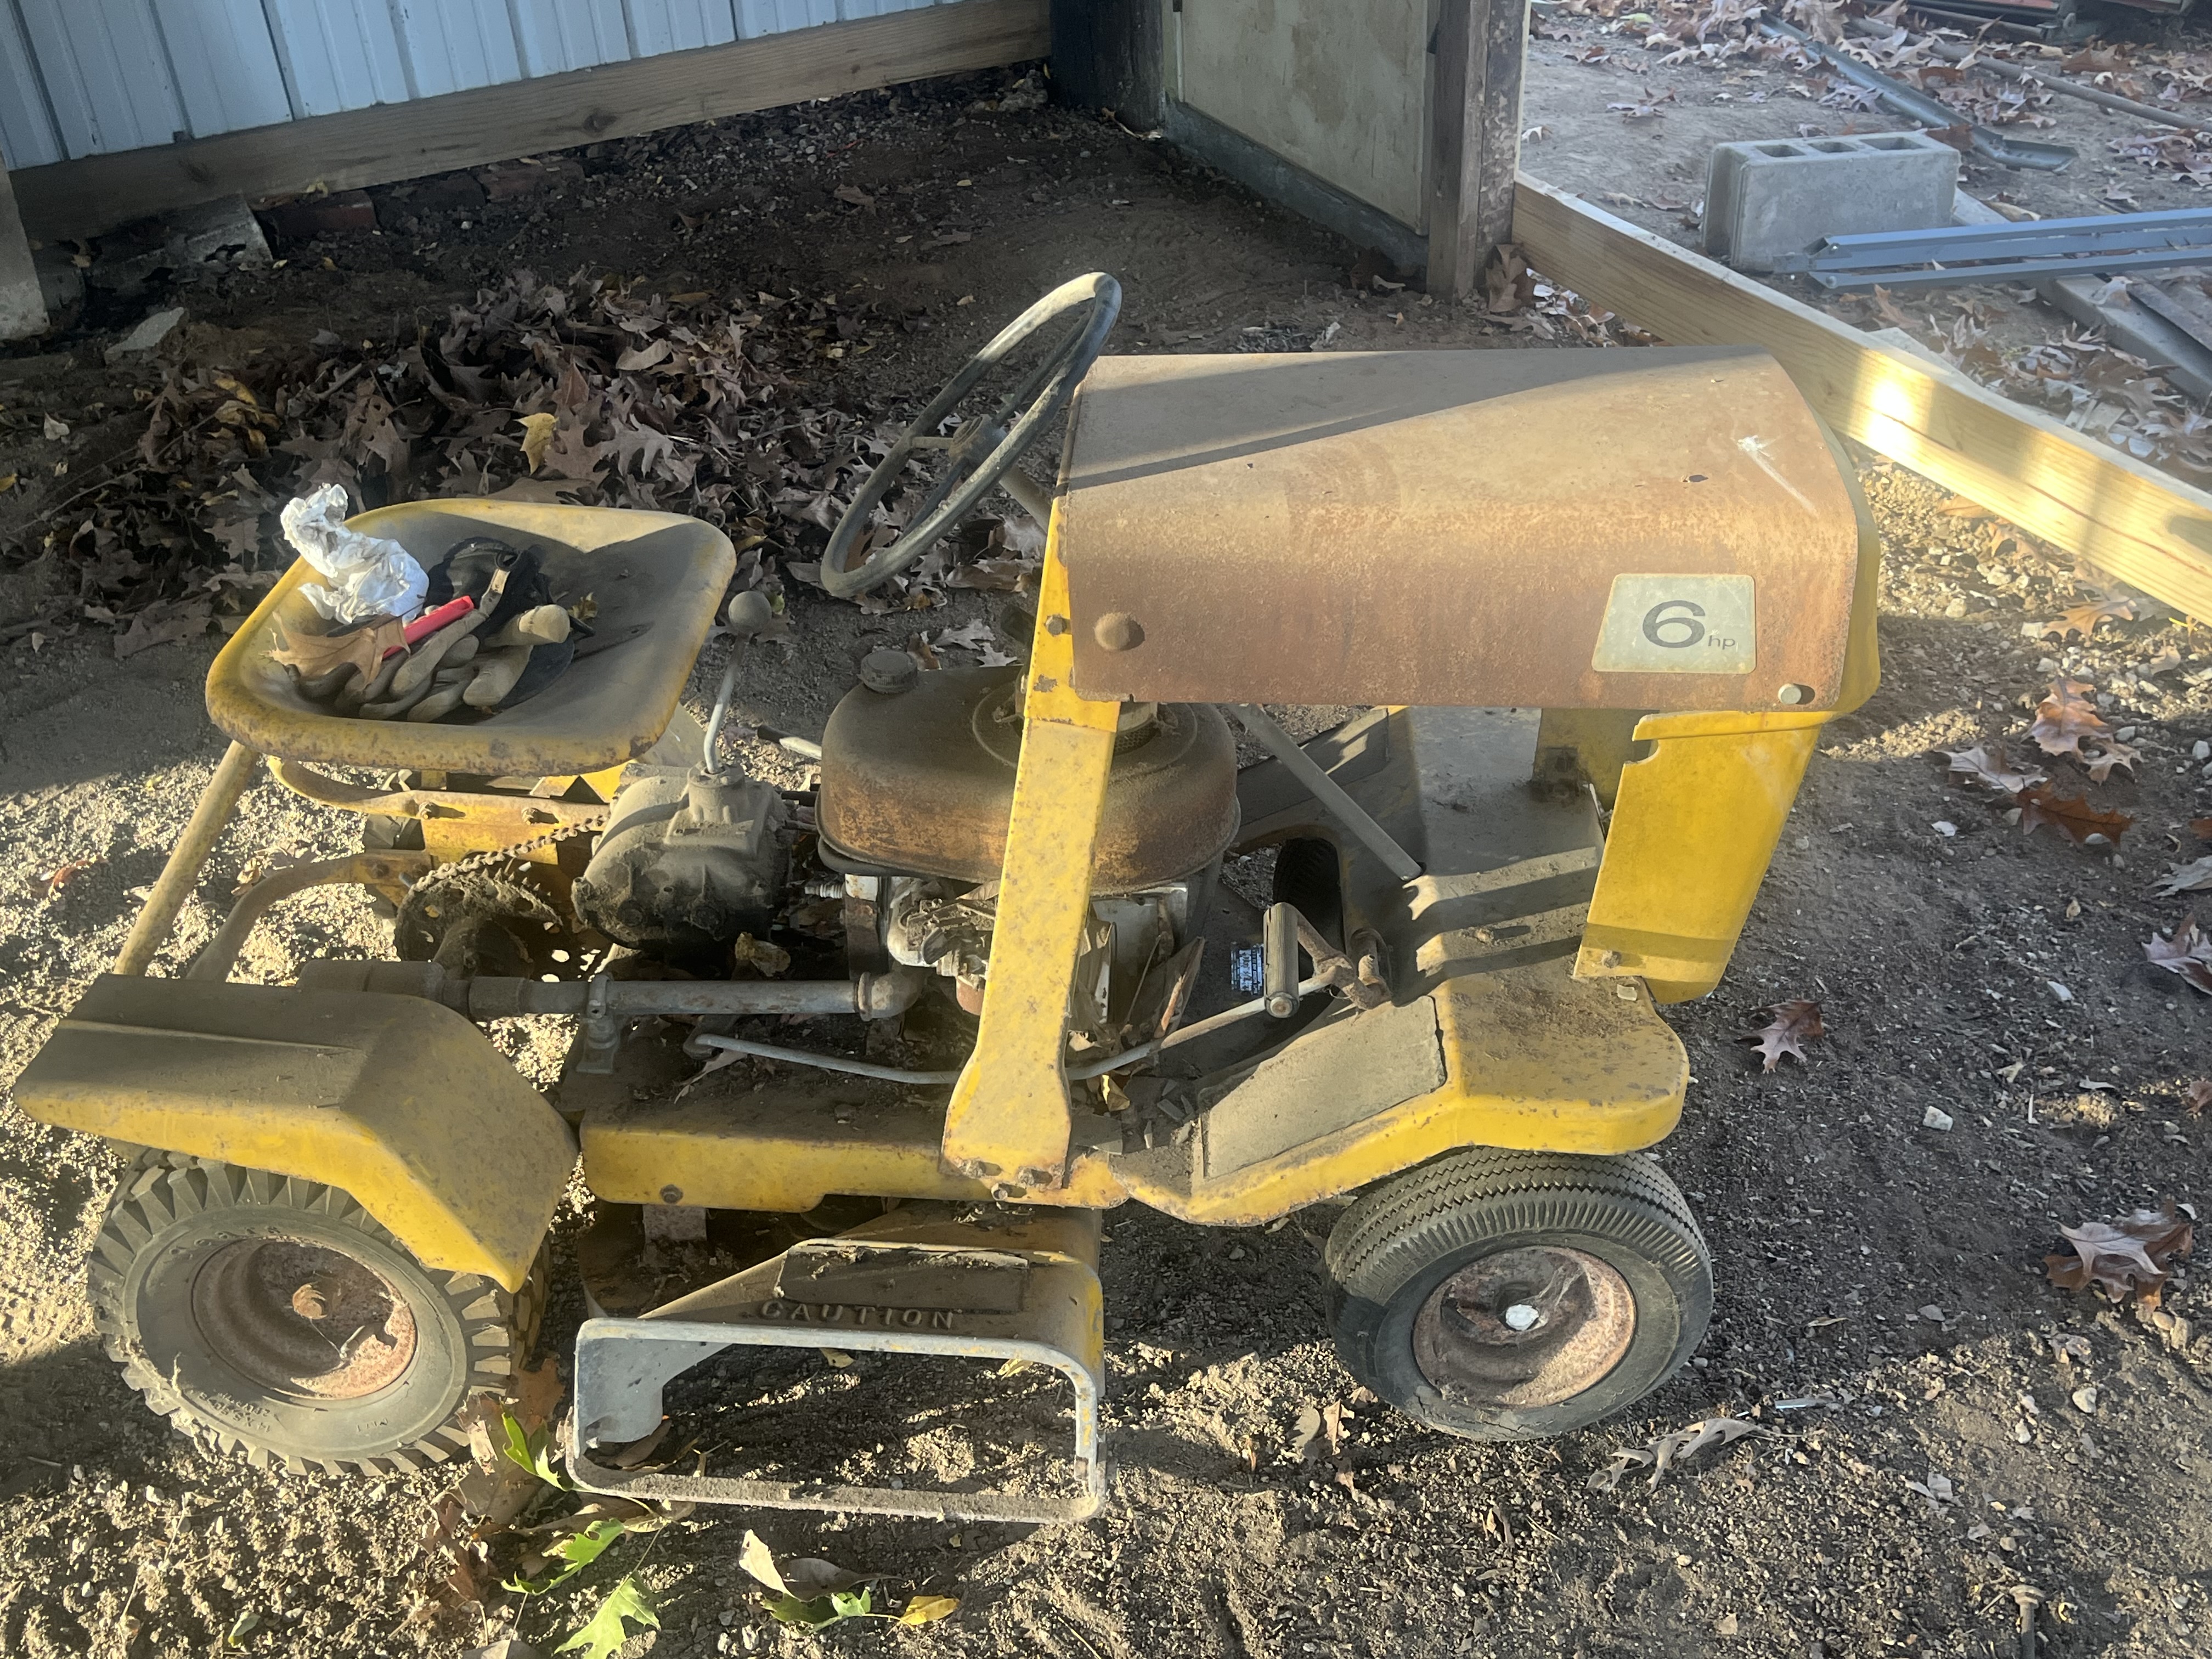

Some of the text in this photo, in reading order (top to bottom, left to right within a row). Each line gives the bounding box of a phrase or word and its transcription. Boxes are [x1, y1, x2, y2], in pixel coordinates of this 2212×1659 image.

[1643, 600, 1735, 650] 6 hp
[760, 1299, 954, 1330] CAUTION
